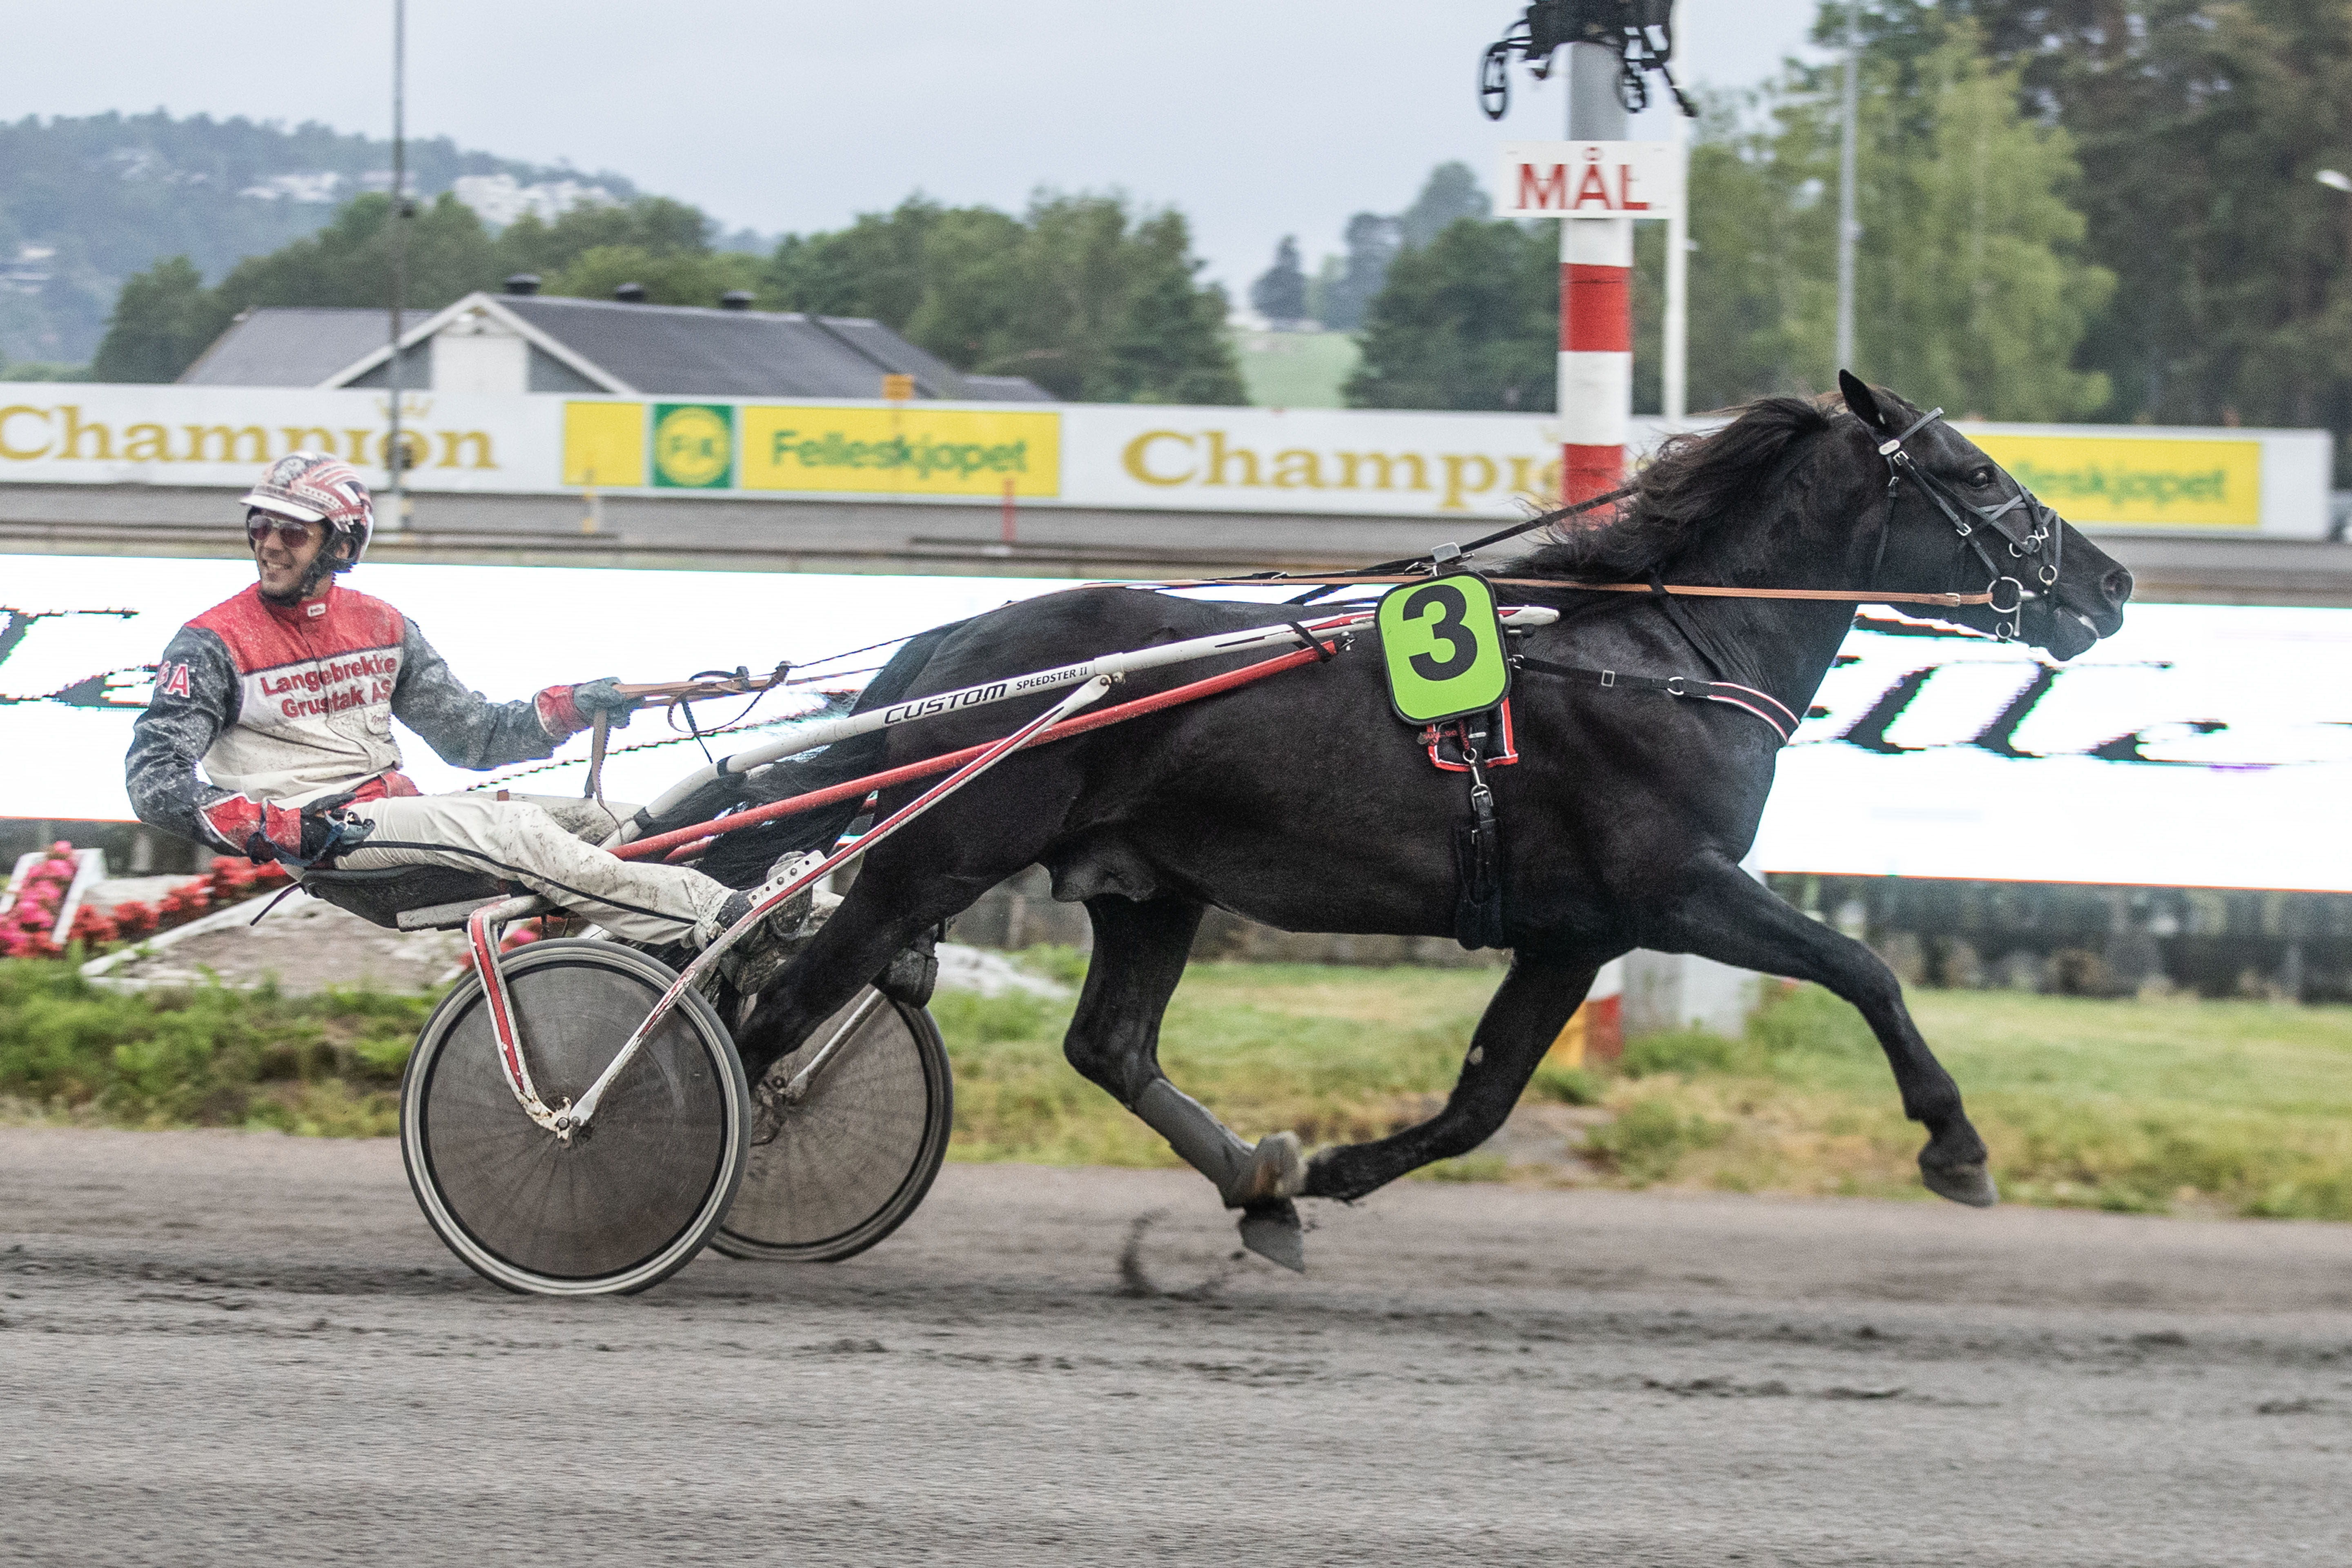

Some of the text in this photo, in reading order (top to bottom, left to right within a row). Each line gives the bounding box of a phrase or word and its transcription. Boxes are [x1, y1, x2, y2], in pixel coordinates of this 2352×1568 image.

[1516, 147, 1650, 211] MÅL
[0, 404, 498, 470] Champion
[1403, 584, 1478, 681] 3
[260, 655, 397, 696] Langebrekke
[281, 686, 366, 718] Grustak
[884, 683, 1008, 725] CUSTOM
[1016, 670, 1077, 691] SPEEDSTER
